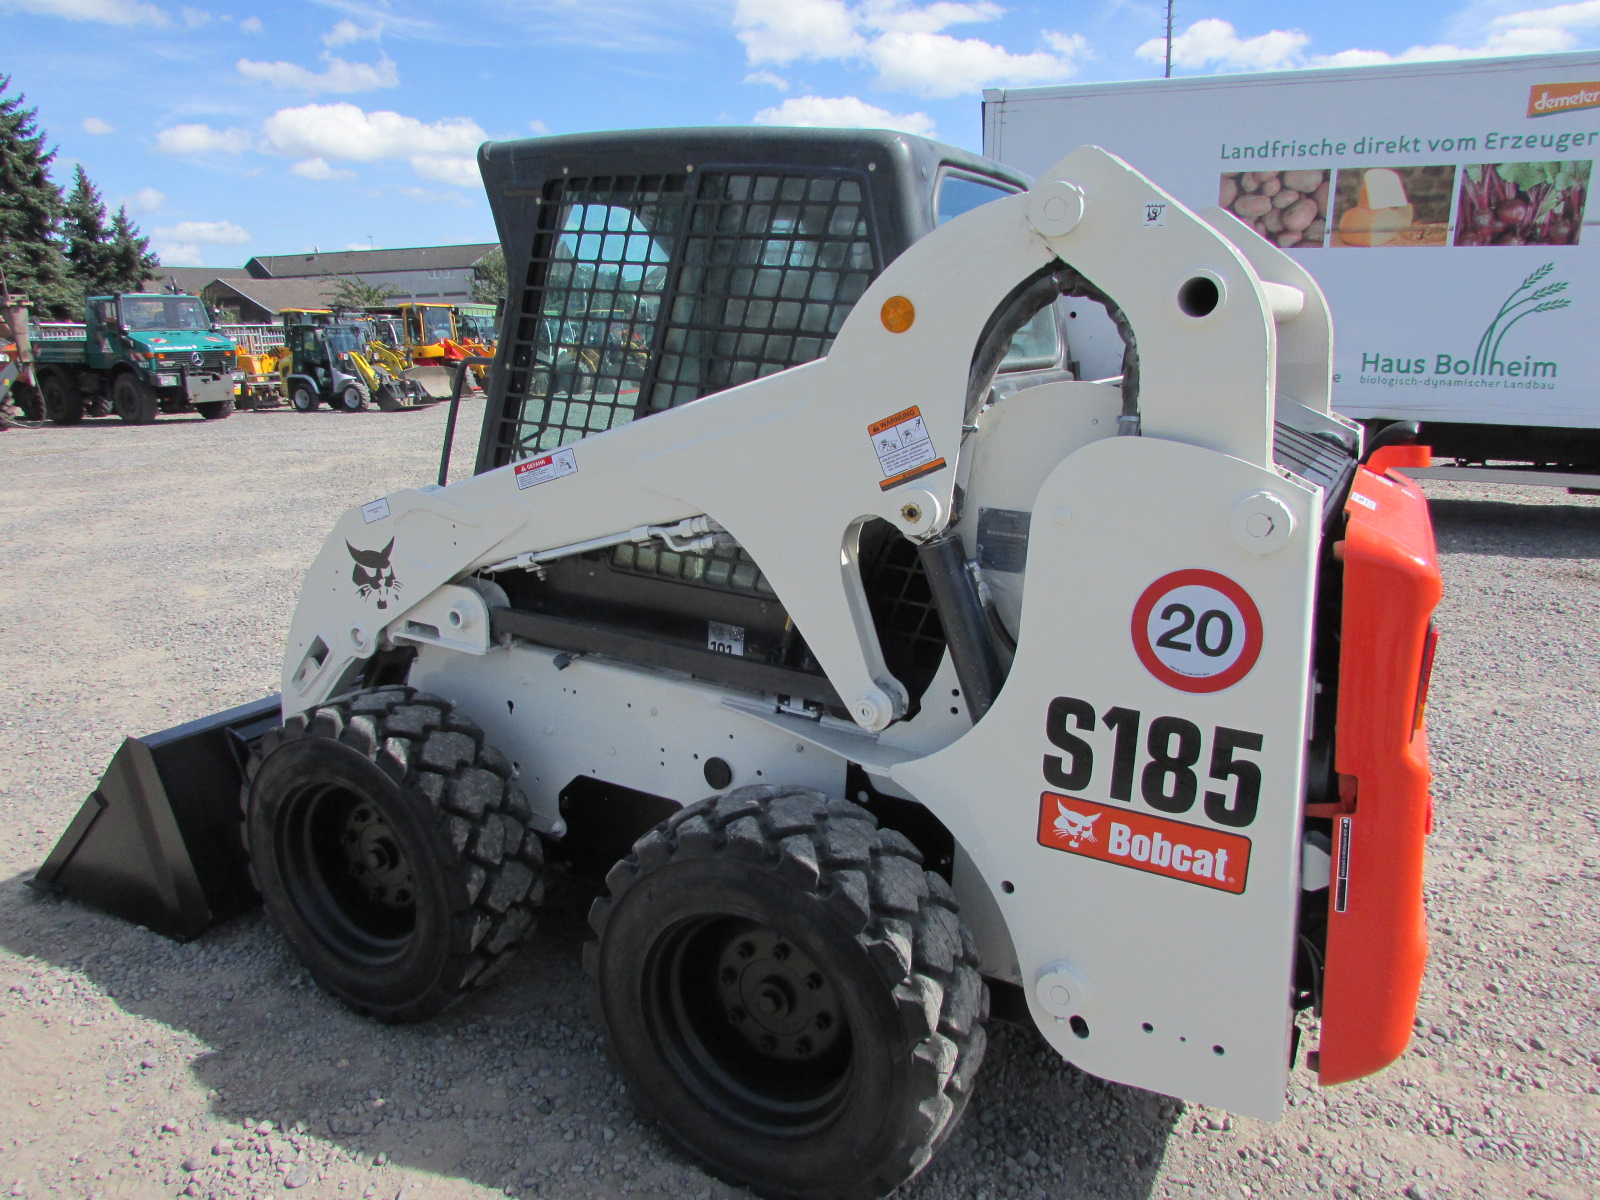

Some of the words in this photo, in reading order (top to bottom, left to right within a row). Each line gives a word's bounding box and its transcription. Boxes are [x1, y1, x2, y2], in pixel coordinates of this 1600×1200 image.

[1535, 90, 1600, 110] demeter
[1220, 138, 1347, 160] Landfrische
[1353, 135, 1421, 155] direkt
[1428, 137, 1477, 152] vom
[1485, 131, 1599, 153] Erzeuger
[1361, 352, 1426, 374] Haus
[1434, 353, 1558, 378] Bollheim
[1359, 375, 1501, 389] biologisch-dynamischer
[1503, 379, 1555, 390] Landbau
[880, 409, 915, 429] WARNUNG
[1155, 602, 1234, 658] 20
[1042, 695, 1264, 828] S185
[1108, 822, 1228, 882] Bobcat
